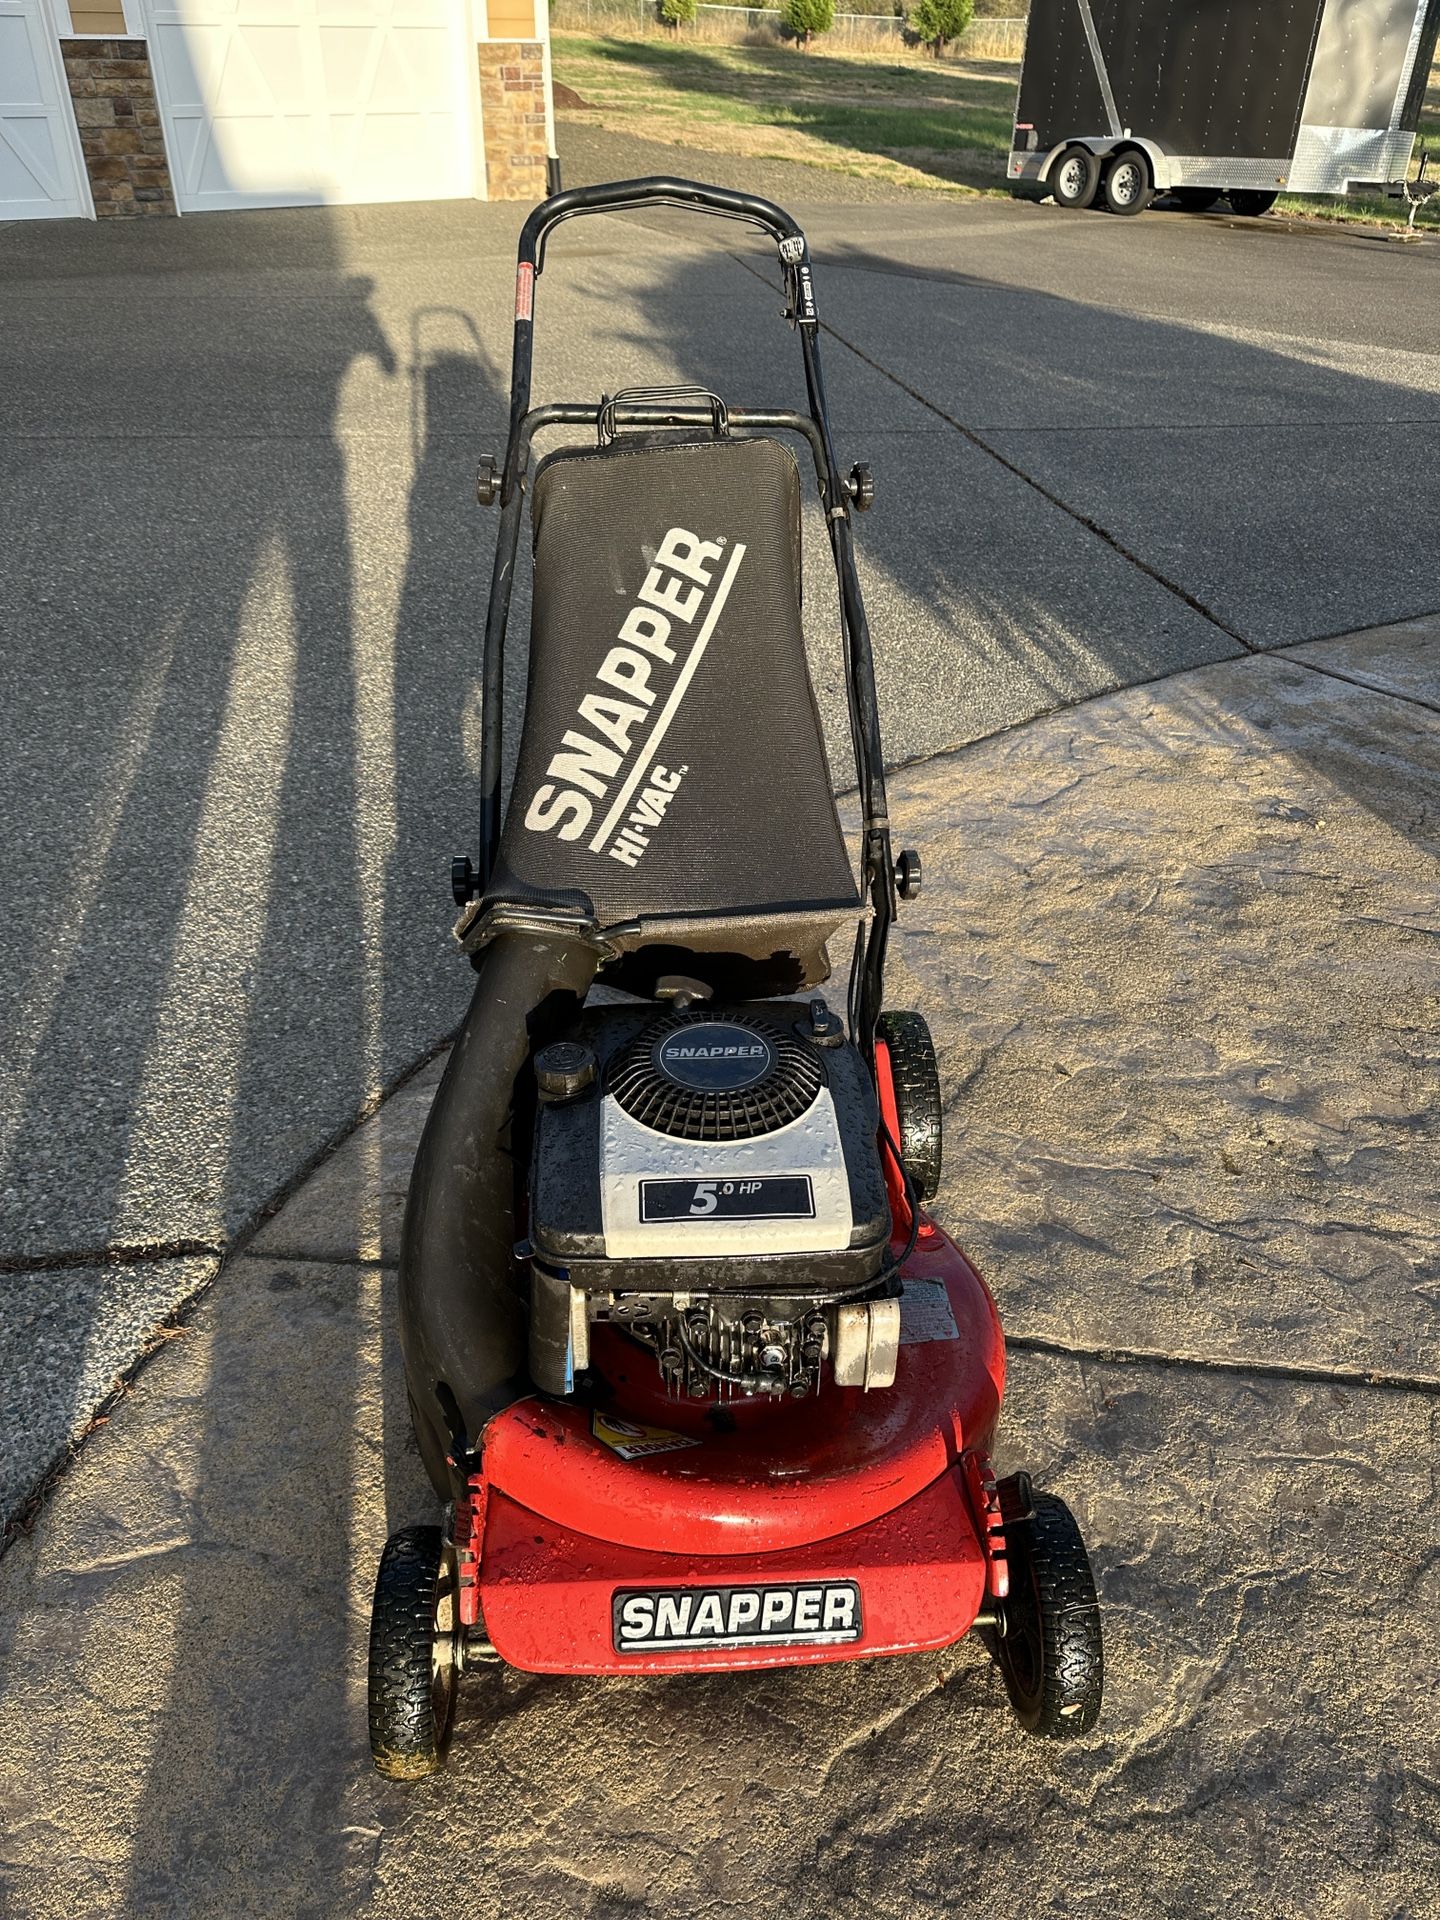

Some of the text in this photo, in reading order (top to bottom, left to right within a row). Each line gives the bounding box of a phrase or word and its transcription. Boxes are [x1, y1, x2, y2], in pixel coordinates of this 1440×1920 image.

[524, 527, 724, 841] SNAPPER
[665, 1045, 765, 1058] SNAPPER
[739, 1182, 763, 1195] HP
[620, 1588, 856, 1639] SNAPPER
